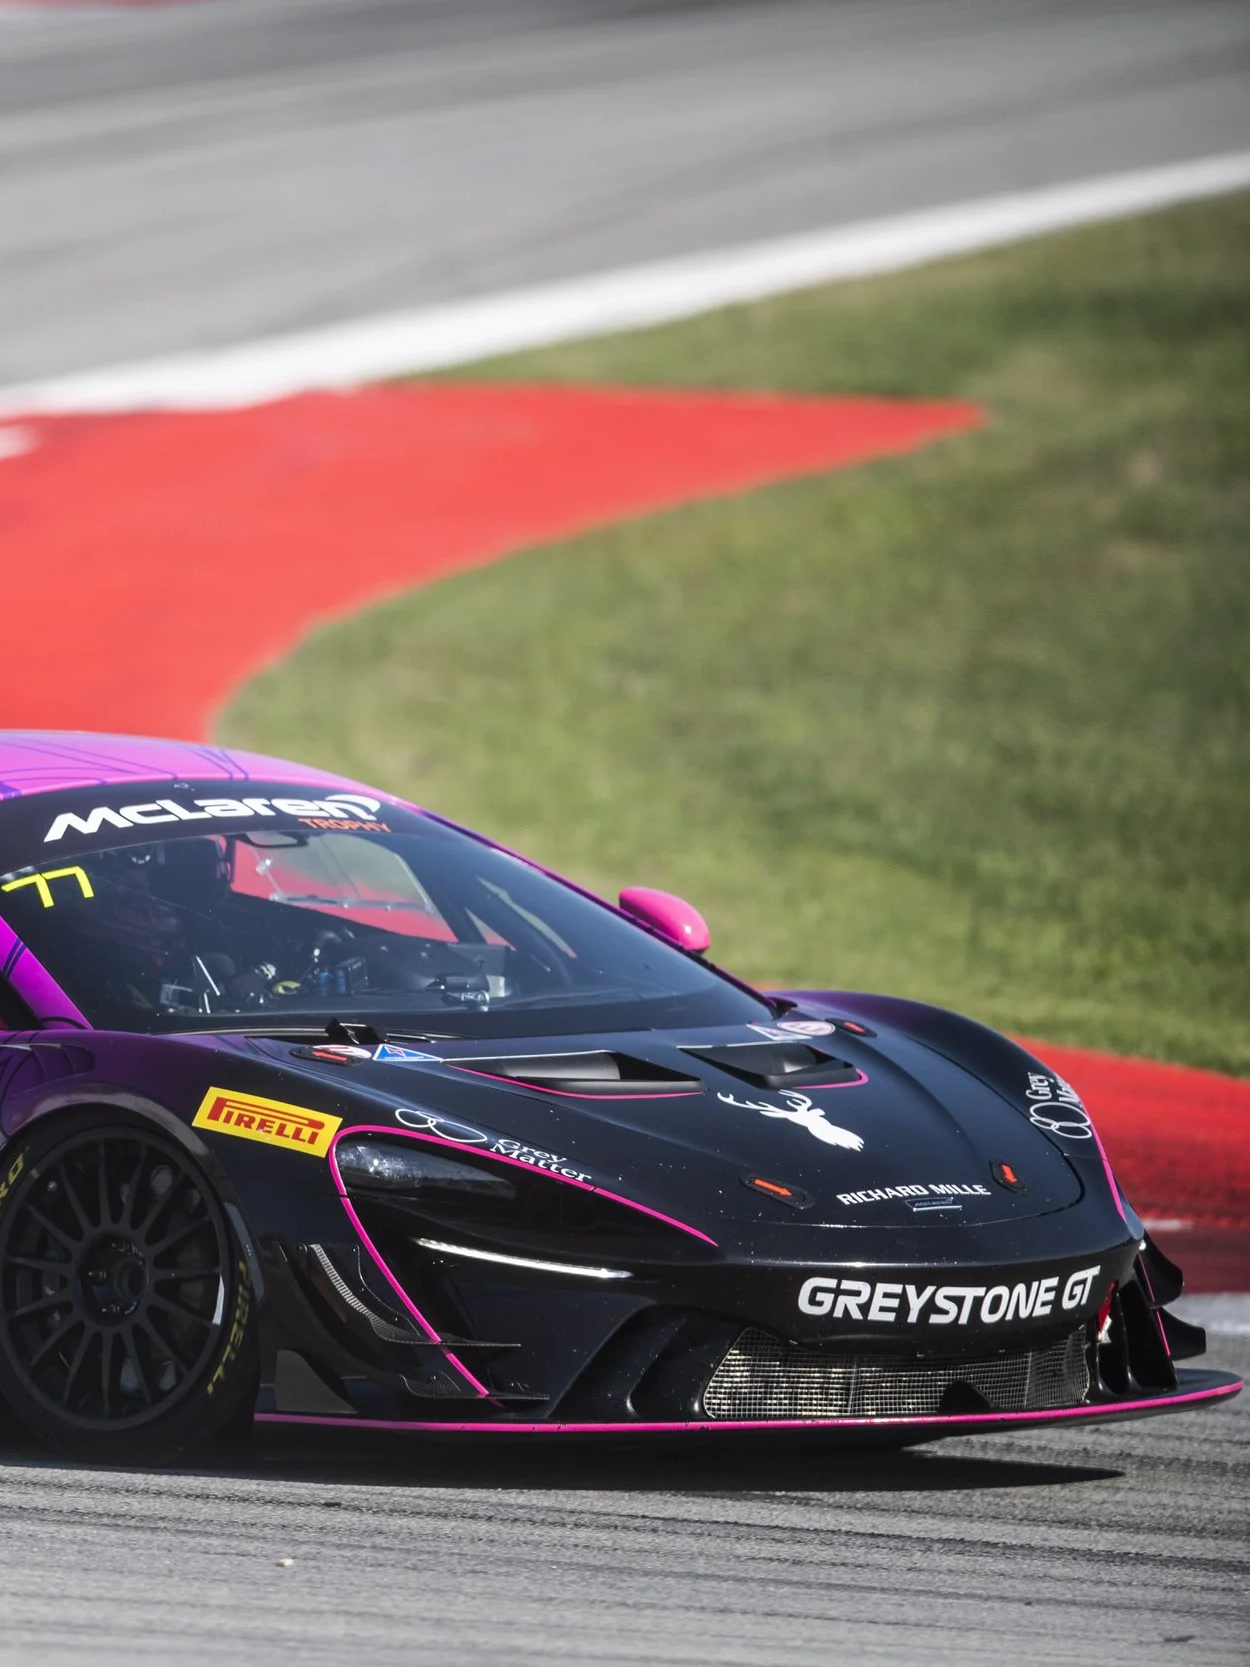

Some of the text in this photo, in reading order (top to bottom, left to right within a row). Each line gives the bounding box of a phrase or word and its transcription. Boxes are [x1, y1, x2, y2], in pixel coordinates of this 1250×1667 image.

[44, 795, 381, 843] McLaren
[298, 817, 392, 834] TROPHY
[0, 865, 95, 909] 77
[207, 1096, 325, 1145] PIRELLI
[490, 1143, 592, 1182] Matter
[498, 1139, 567, 1163] Grey
[836, 1184, 992, 1206] RICHARD MILLE
[798, 1264, 1101, 1325] GREYSTONE GT
